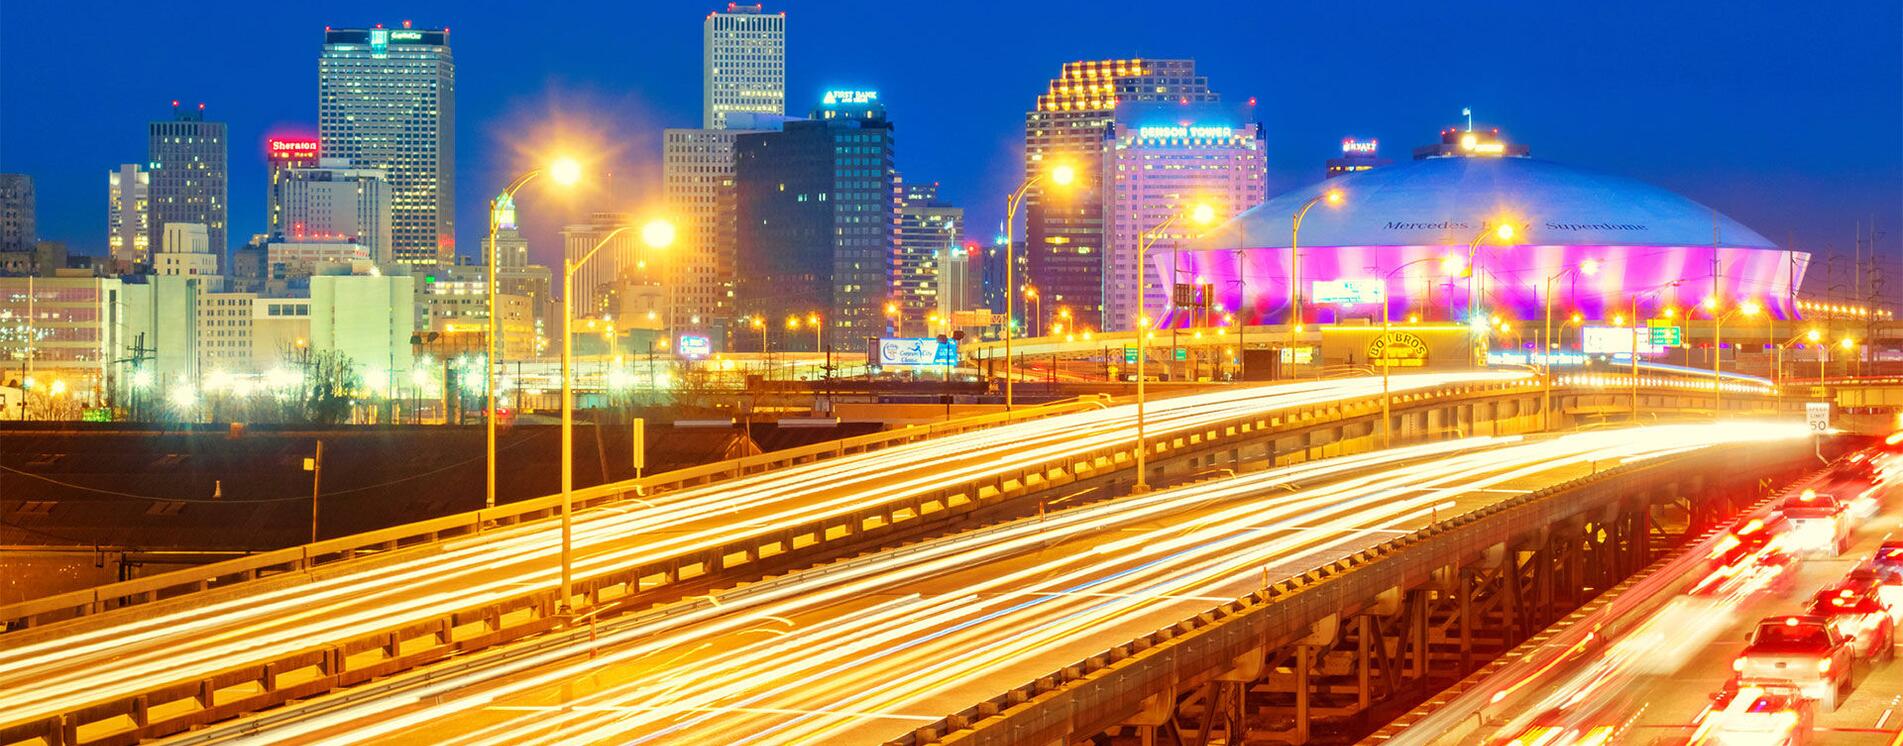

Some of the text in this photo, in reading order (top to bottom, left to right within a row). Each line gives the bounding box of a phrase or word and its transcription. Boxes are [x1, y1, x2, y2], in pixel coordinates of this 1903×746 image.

[834, 90, 877, 99] FIRST BANK
[1140, 127, 1231, 138] BENSON TOWER
[273, 141, 317, 150] Sheraton
[1545, 223, 1649, 231] Superdome
[1395, 333, 1426, 354] BROS
[1809, 420, 1827, 431] 50
